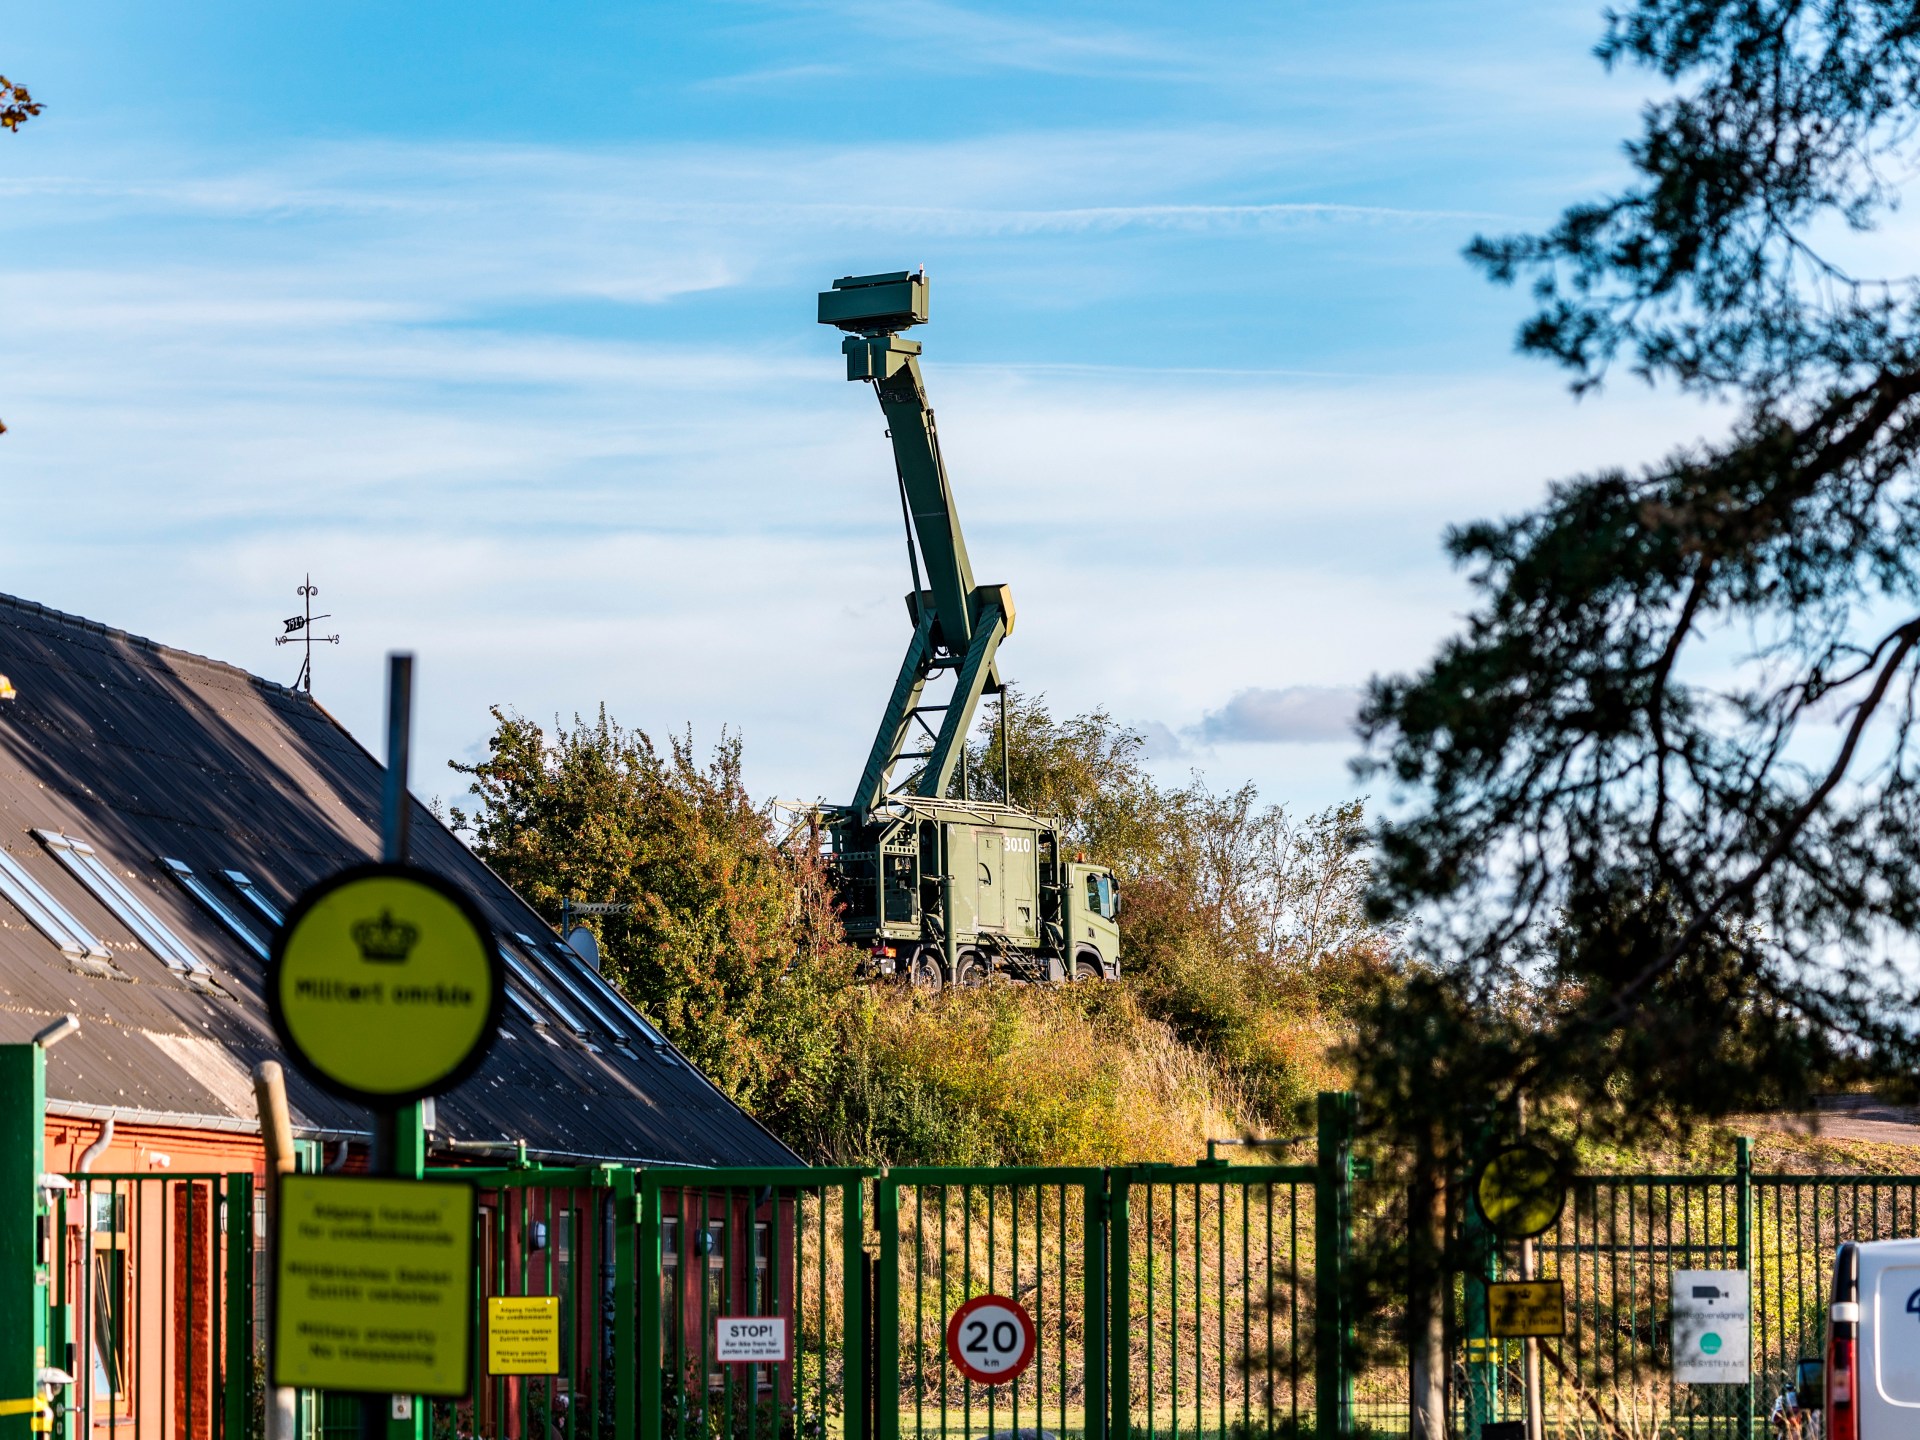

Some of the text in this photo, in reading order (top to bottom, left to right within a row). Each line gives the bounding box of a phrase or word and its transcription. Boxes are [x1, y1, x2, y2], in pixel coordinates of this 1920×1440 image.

[1004, 837, 1030, 852] 3010
[730, 1325, 772, 1337] STOP!
[966, 1320, 1018, 1353] 20
[984, 1358, 999, 1367] km
